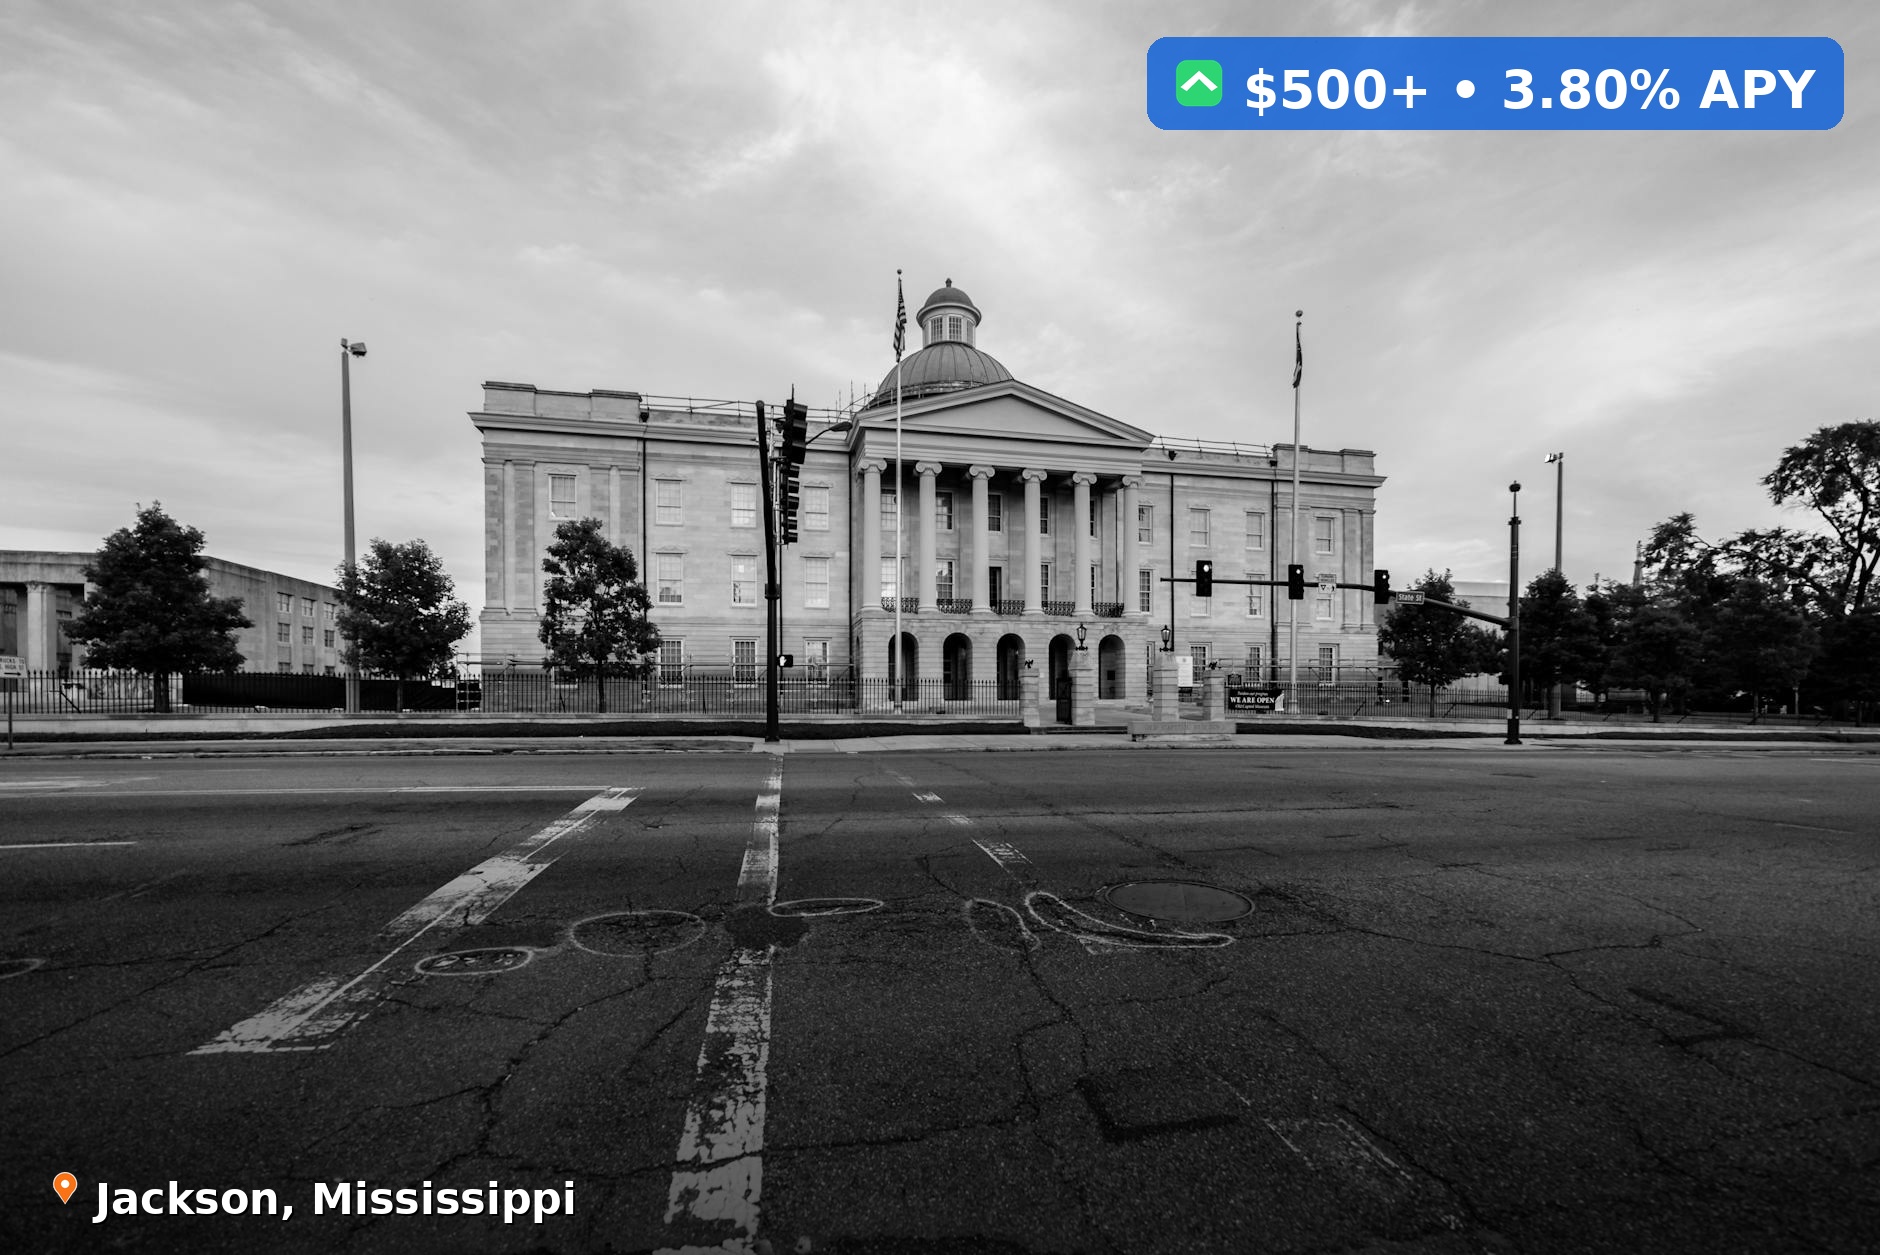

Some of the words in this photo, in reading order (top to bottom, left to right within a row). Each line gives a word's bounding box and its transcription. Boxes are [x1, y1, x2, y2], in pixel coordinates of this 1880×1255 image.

[1398, 593, 1414, 602] State
[1230, 696, 1241, 704] WE
[1241, 696, 1255, 704] ARE
[1256, 696, 1275, 704] OPEN
